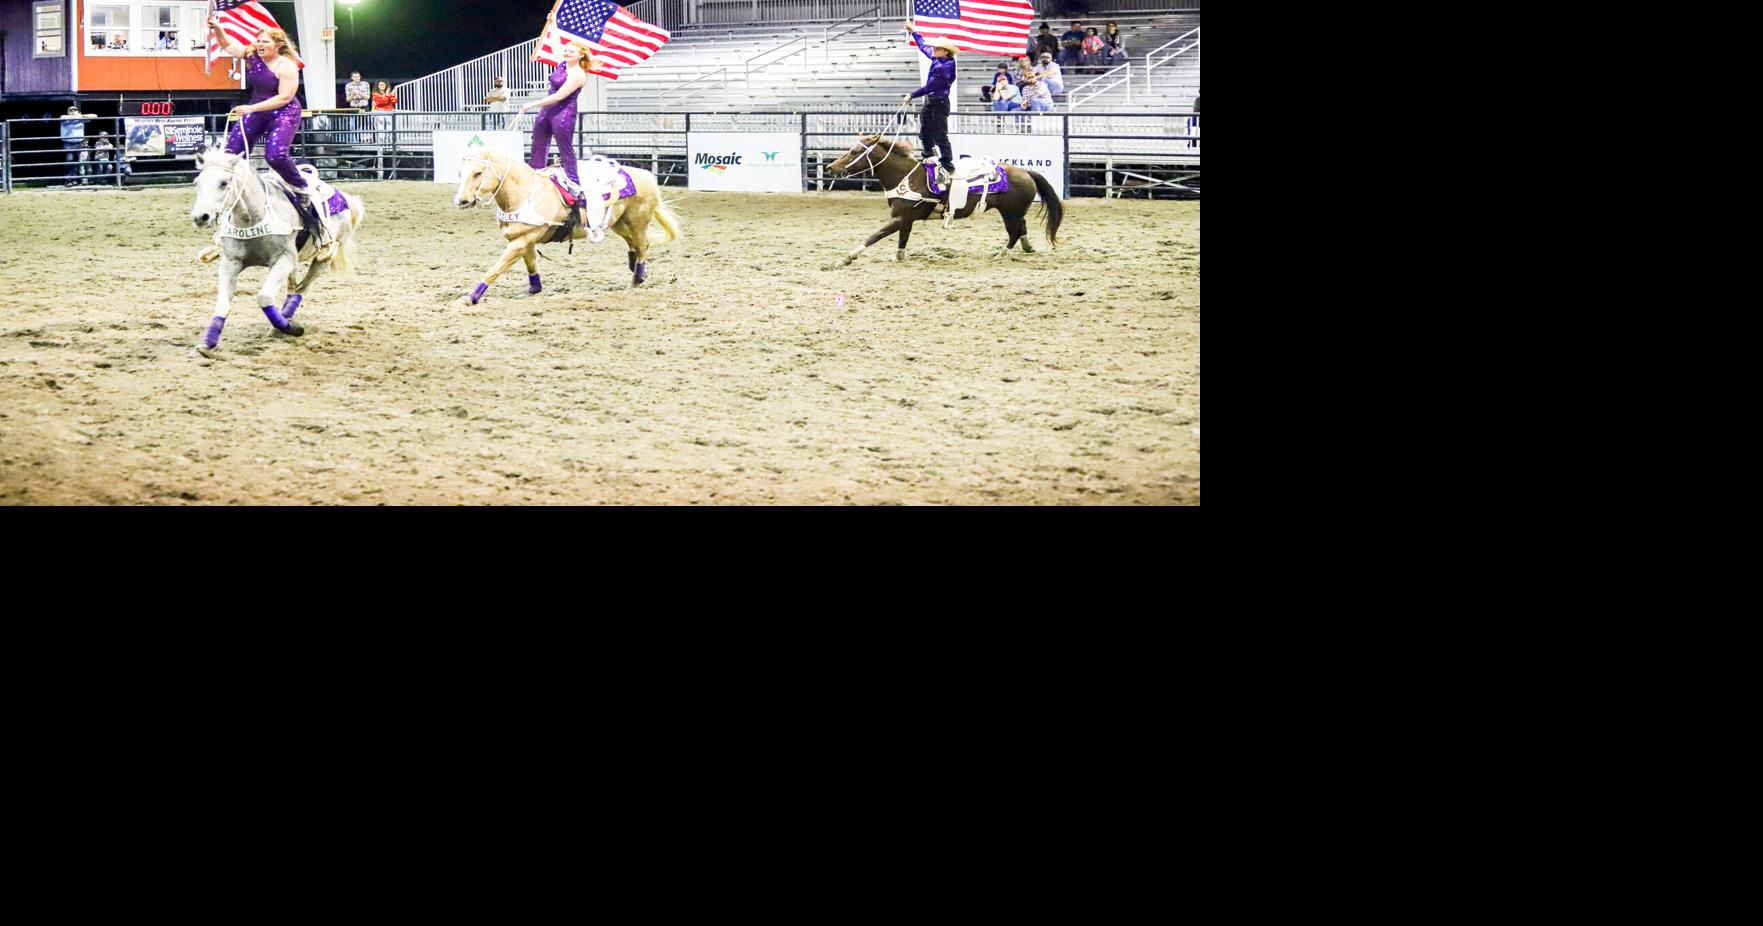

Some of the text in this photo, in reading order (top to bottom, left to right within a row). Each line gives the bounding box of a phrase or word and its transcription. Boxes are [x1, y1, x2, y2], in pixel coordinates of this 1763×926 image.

[141, 102, 171, 115] 0.00
[172, 125, 203, 134] Seminole
[175, 133, 204, 142] Wellness
[694, 152, 742, 165] Mosaic
